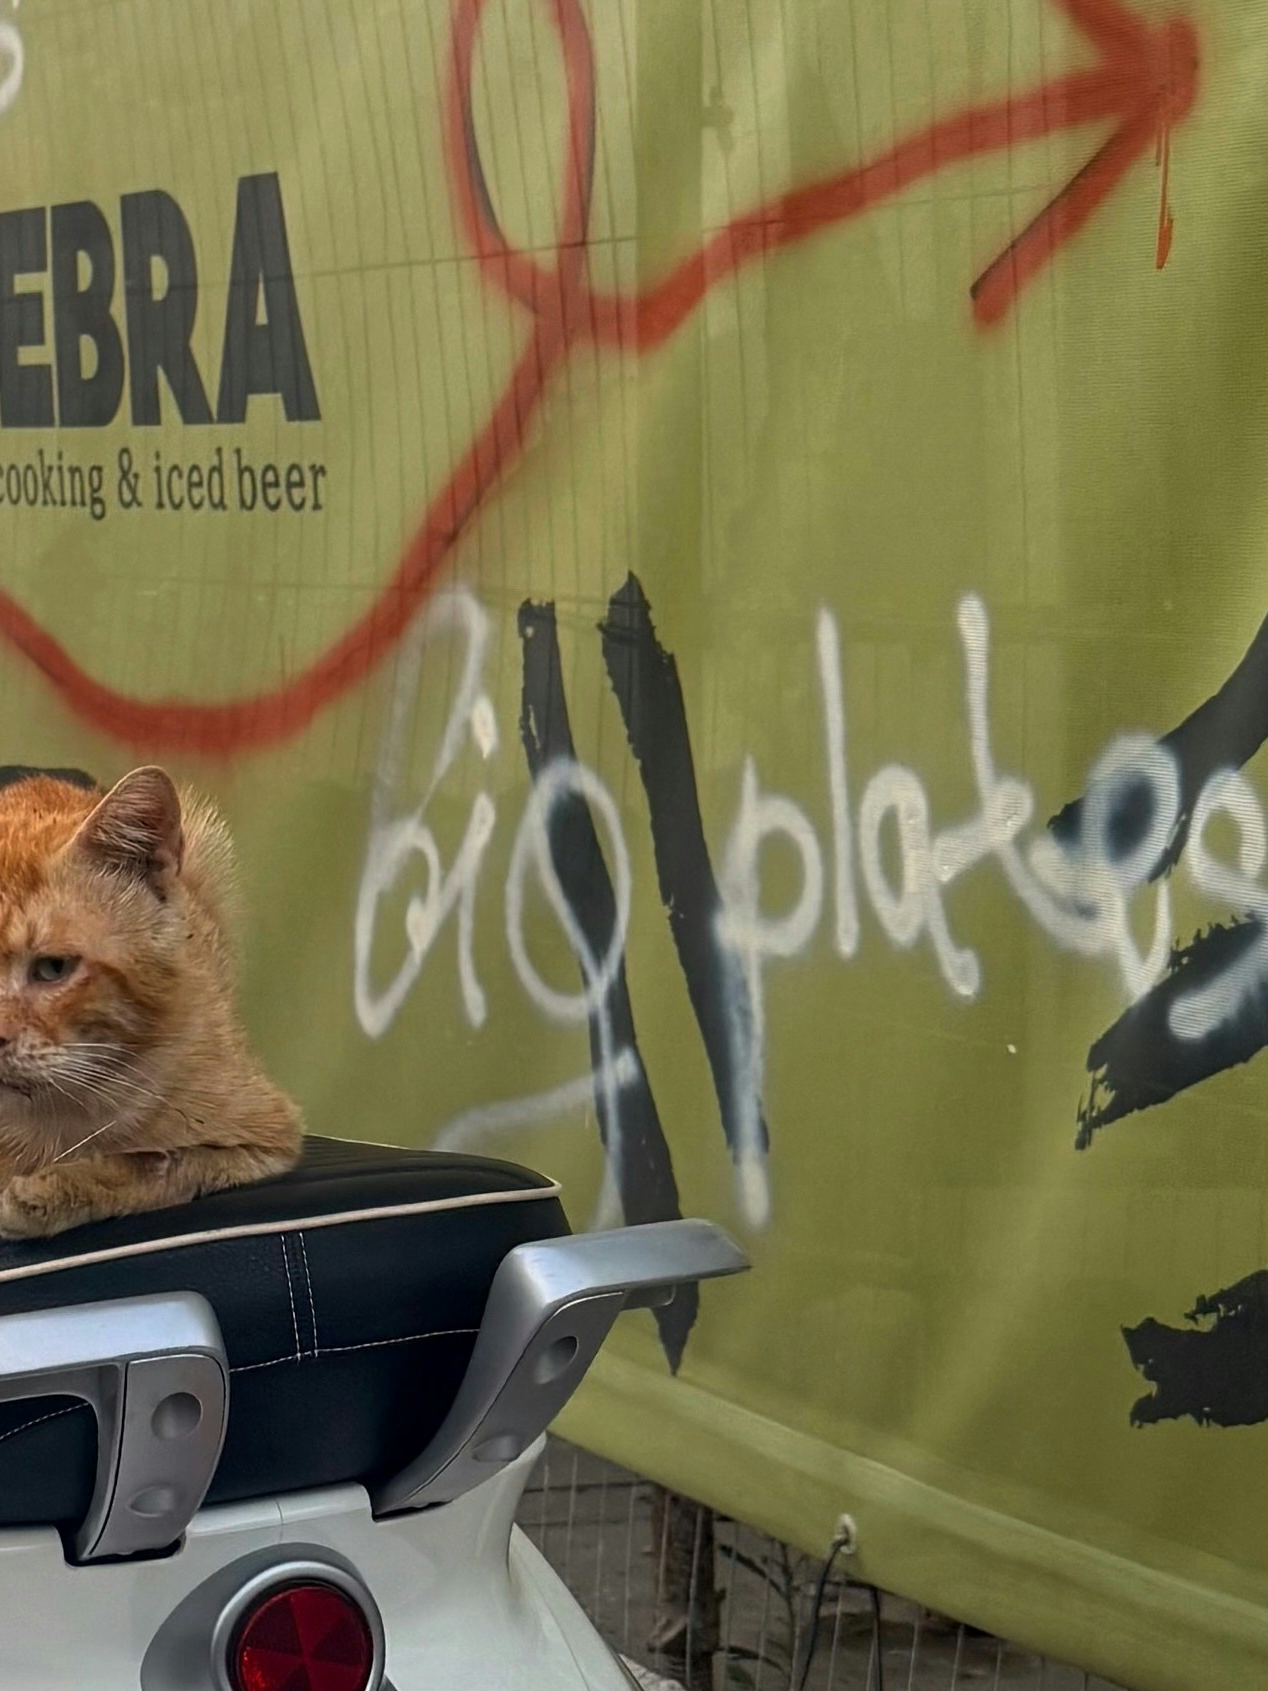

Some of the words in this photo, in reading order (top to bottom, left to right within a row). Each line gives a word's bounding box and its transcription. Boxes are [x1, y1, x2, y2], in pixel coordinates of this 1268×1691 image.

[117, 446, 143, 510] &
[154, 446, 229, 511] iced
[235, 447, 328, 512] beer
